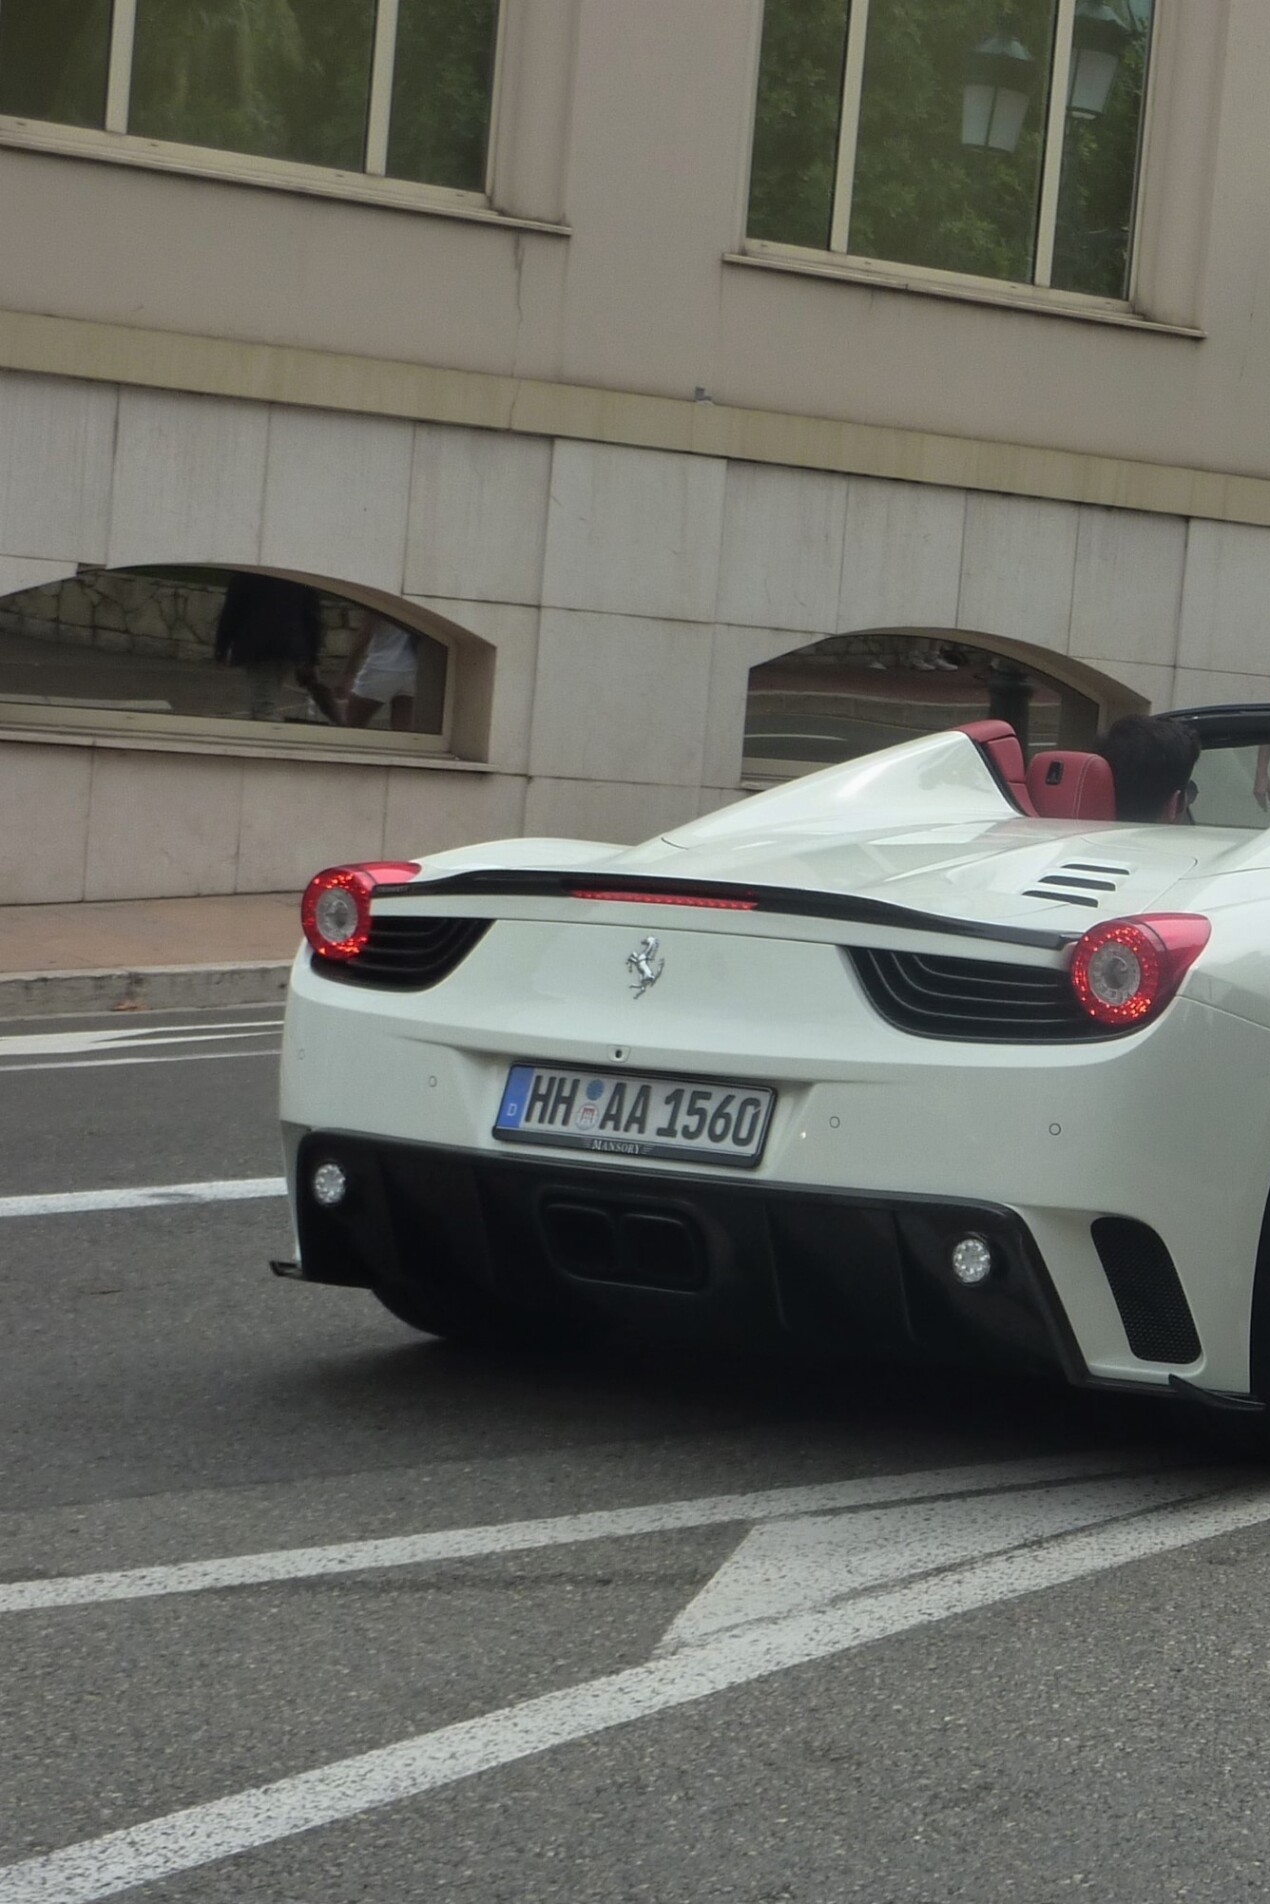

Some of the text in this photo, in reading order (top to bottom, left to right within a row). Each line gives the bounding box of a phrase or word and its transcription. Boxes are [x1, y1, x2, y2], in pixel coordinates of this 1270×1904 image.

[506, 1103, 517, 1117] D
[524, 1075, 761, 1147] HH AA 1560
[591, 1138, 640, 1155] MANSORY
